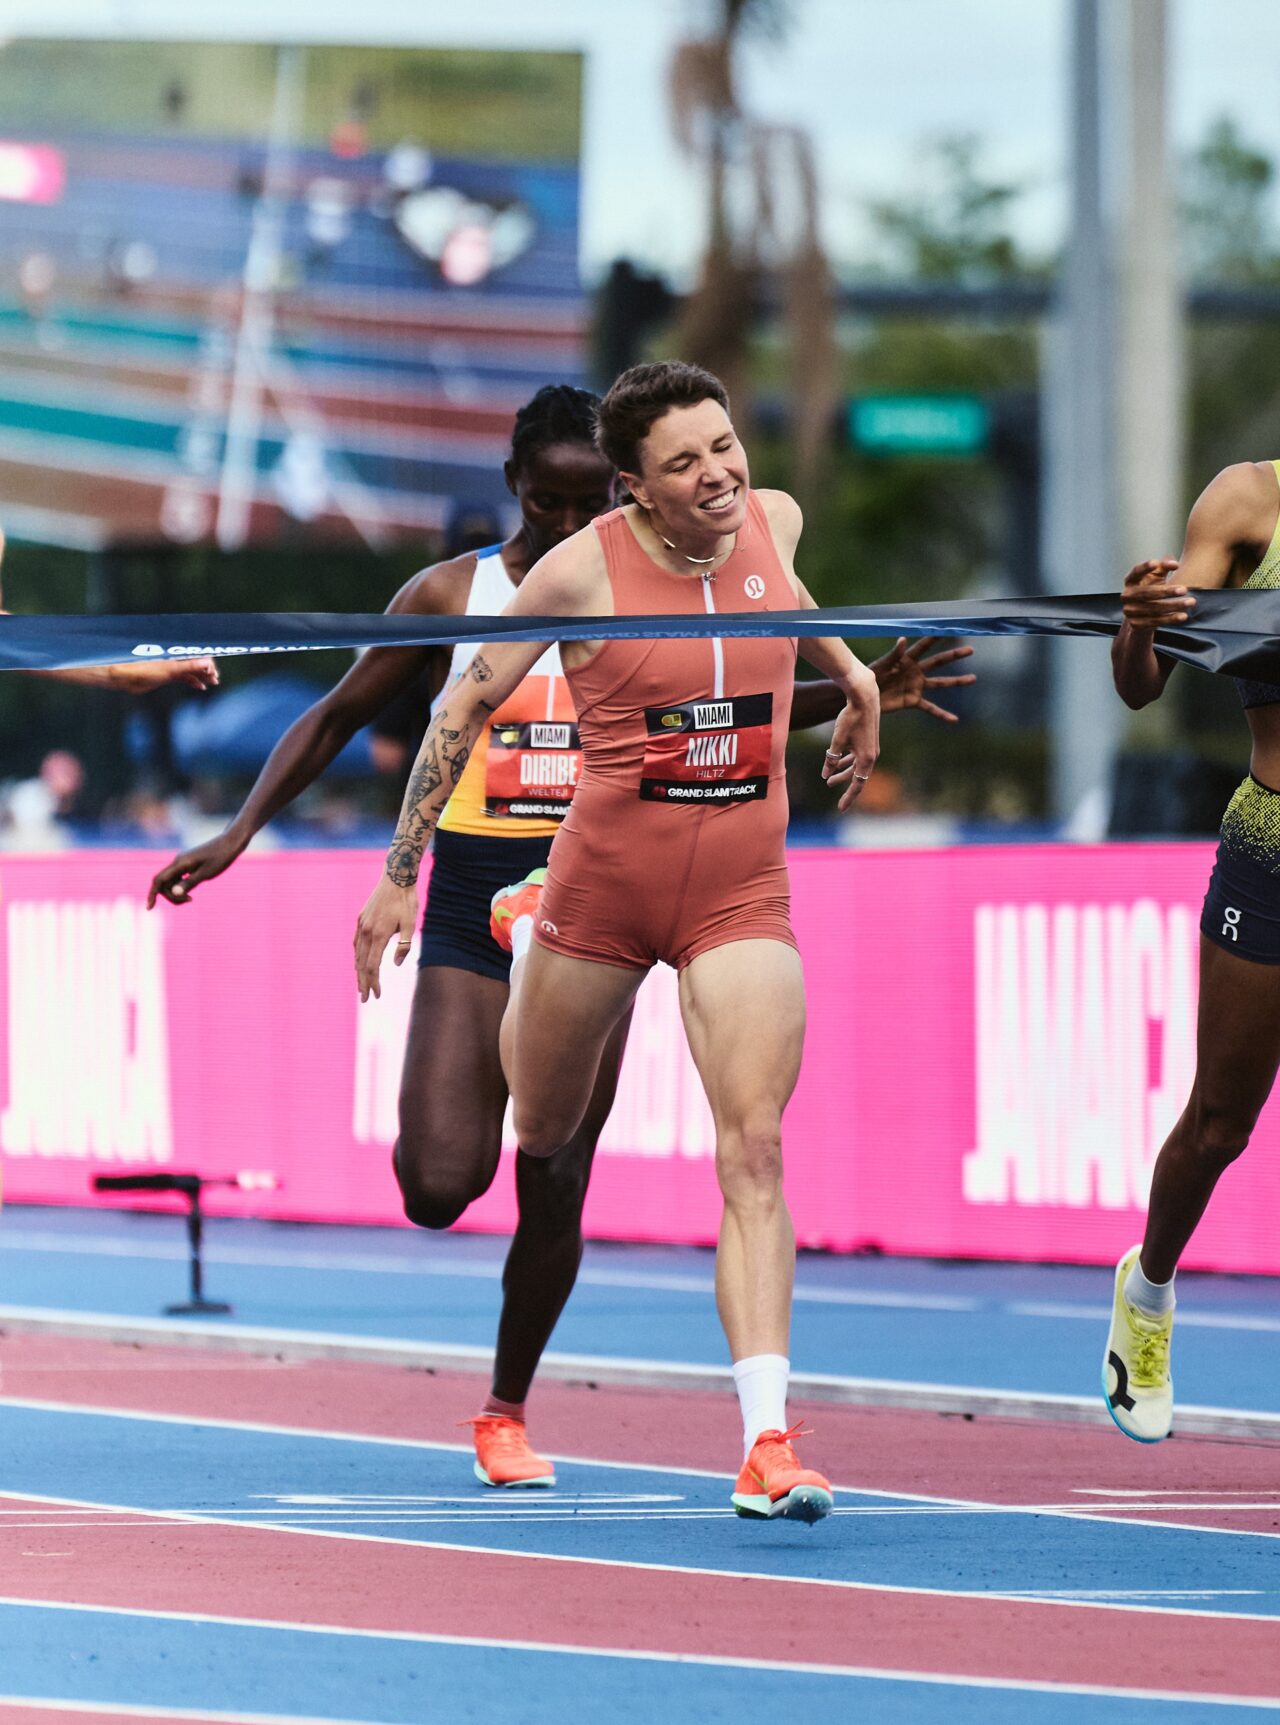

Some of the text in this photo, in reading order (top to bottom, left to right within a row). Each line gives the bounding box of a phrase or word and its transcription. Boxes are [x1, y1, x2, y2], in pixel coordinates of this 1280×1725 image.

[697, 705, 730, 726] MIAMI
[534, 728, 566, 744] MIAMI
[685, 734, 738, 766] NIKKI
[520, 754, 577, 785] DIRIBE
[696, 769, 725, 778] HILTZ
[667, 784, 756, 797] GRAND SLAM TRACK
[509, 804, 543, 814] GRAND
